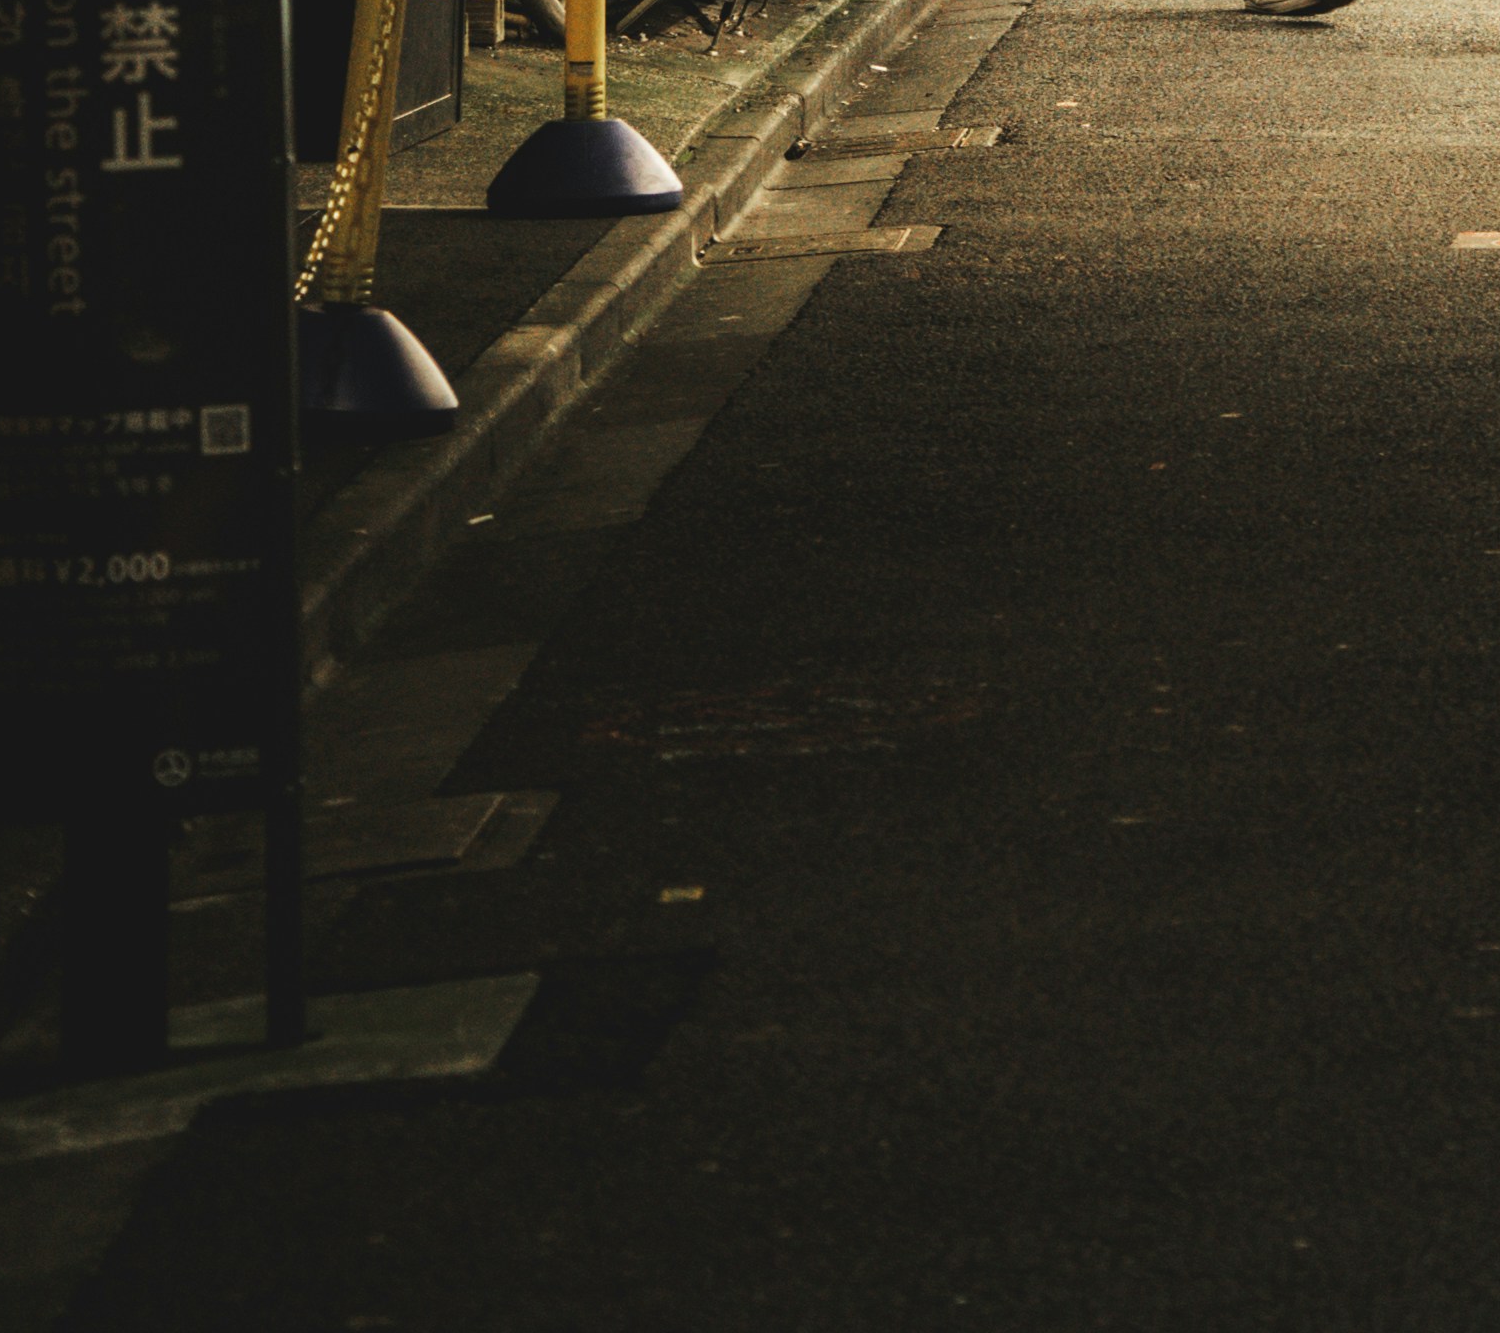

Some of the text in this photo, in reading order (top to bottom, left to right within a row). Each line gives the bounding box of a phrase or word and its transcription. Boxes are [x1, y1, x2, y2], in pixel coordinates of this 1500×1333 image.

[44, 64, 90, 151] the
[44, 166, 89, 317] street
[53, 551, 172, 588] ¥2,000
